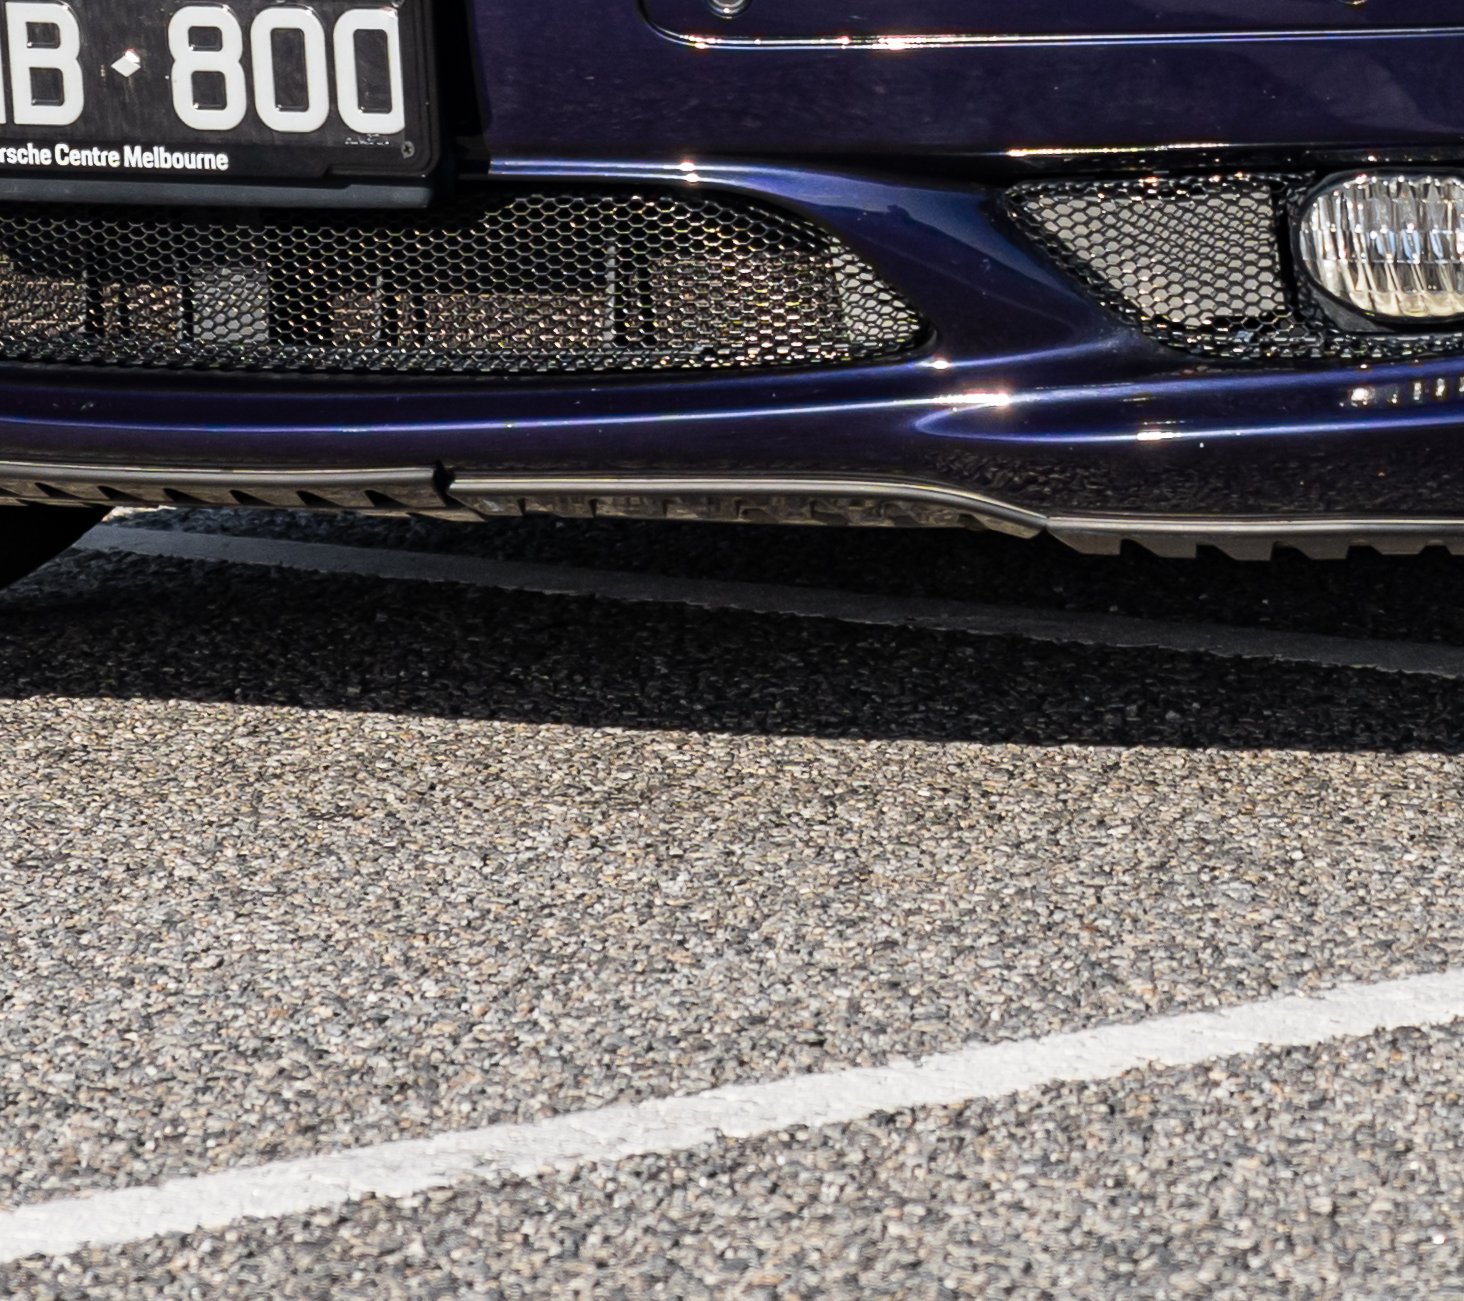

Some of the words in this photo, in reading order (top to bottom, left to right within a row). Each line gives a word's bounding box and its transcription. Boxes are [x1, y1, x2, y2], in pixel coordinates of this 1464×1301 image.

[167, 2, 406, 135] 800
[55, 143, 120, 167] Centre
[124, 144, 229, 171] Melbourne
